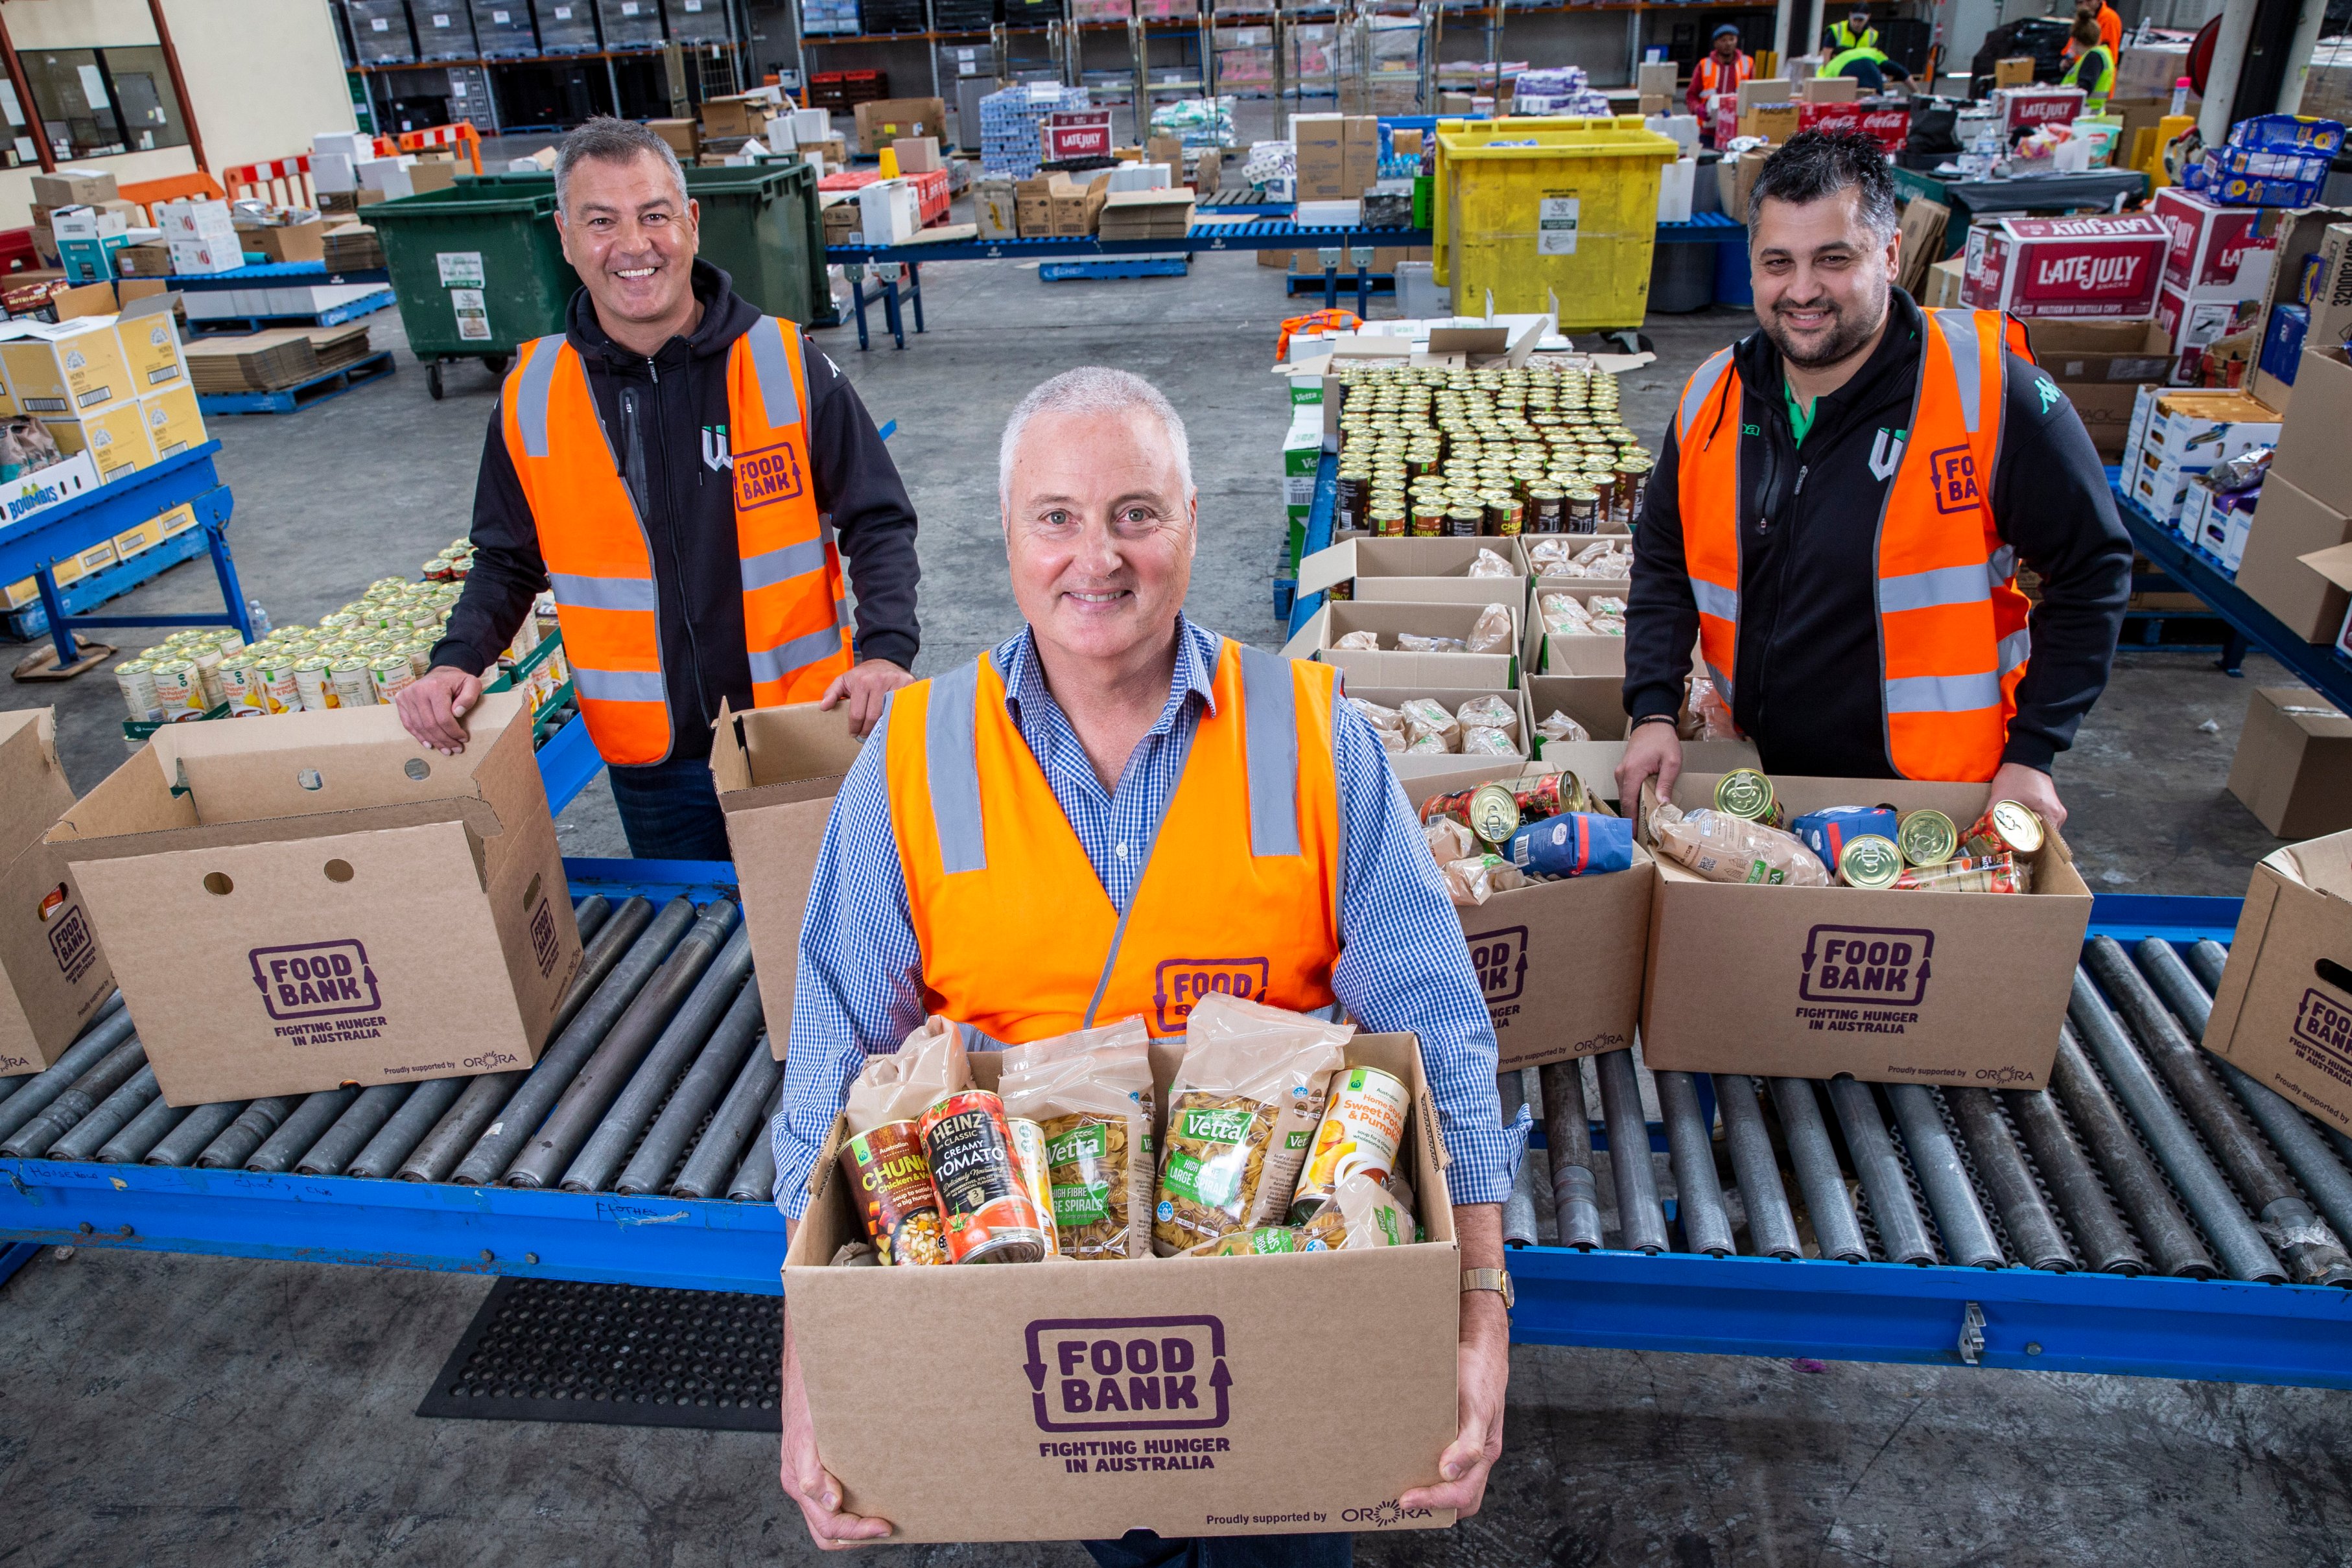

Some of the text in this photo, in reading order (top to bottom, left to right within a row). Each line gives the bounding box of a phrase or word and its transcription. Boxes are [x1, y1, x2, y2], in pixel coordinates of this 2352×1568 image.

[1295, 392, 1317, 402] Vetta
[739, 454, 786, 482] FOOD
[1946, 456, 1975, 479] FO
[743, 473, 790, 500] BANK
[1949, 477, 1979, 502] BA
[8, 486, 59, 520] BOUMBIS
[55, 917, 80, 948] FOOD
[61, 928, 86, 962] BANK
[1473, 942, 1510, 970] OD
[1825, 939, 1912, 966] FOOD
[270, 954, 353, 983] FOOD
[1477, 966, 1509, 992] NK
[1819, 965, 1909, 992] BANK
[278, 976, 362, 1007] BANK
[1174, 972, 1252, 1003] FOOD
[1490, 1004, 1520, 1018] NGER
[1796, 1007, 1918, 1024] FIGHTING HUNGER
[2311, 1001, 2352, 1036] FOO
[274, 1016, 388, 1037] FIGHTING HUNGER
[292, 1029, 381, 1046] IN AUSTRALIA
[1809, 1020, 1904, 1034] IN AUSTRALIA
[1524, 1048, 1557, 1061] supported
[1556, 1046, 1567, 1055] by
[2288, 1036, 2352, 1079] FIGHTING HUNG
[384, 1060, 456, 1075] Proudly supported by
[1888, 1065, 1967, 1078] Proudly supported by
[2295, 1049, 2352, 1087] IN AUSTRALIA
[1363, 1094, 1402, 1122] Home Style
[1376, 1087, 1399, 1104] Australian
[2275, 1073, 2350, 1124] Proudly supported by
[1343, 1099, 1382, 1119] Sweet
[932, 1113, 983, 1144] HEINZ
[944, 1130, 978, 1147] CLASSIC
[1188, 1114, 1241, 1141] Vetta
[1348, 1110, 1400, 1147] & Pumpkin
[1357, 1130, 1370, 1139] soup
[879, 1141, 909, 1155] Australian
[944, 1140, 984, 1160] CREAMY
[1046, 1137, 1100, 1165] Vetta
[1353, 1134, 1381, 1149] wholesome
[862, 1155, 928, 1192] CHUNK
[935, 1147, 1005, 1182] TOMATO
[1184, 1159, 1199, 1173] HIGH
[878, 1176, 912, 1195] Chicken
[943, 1165, 1004, 1193] Deliciously Nourishing
[1170, 1165, 1193, 1186] LARGE
[1194, 1176, 1230, 1198] SPIRALS
[892, 1192, 908, 1203] soup
[915, 1185, 933, 1197] satisfy
[902, 1198, 911, 1208] big
[911, 1191, 934, 1206] hunger!
[972, 1189, 979, 1199] 3
[1067, 1186, 1087, 1198] FIBRE
[1065, 1199, 1103, 1212] SPIRALS
[1057, 1337, 1195, 1375] FOOD
[1061, 1375, 1199, 1413] BANK
[1039, 1437, 1230, 1457] FIGHTING HUNGER
[1065, 1455, 1215, 1473] IN AUSTRALIA
[1206, 1510, 1327, 1527] Proudly supported by
